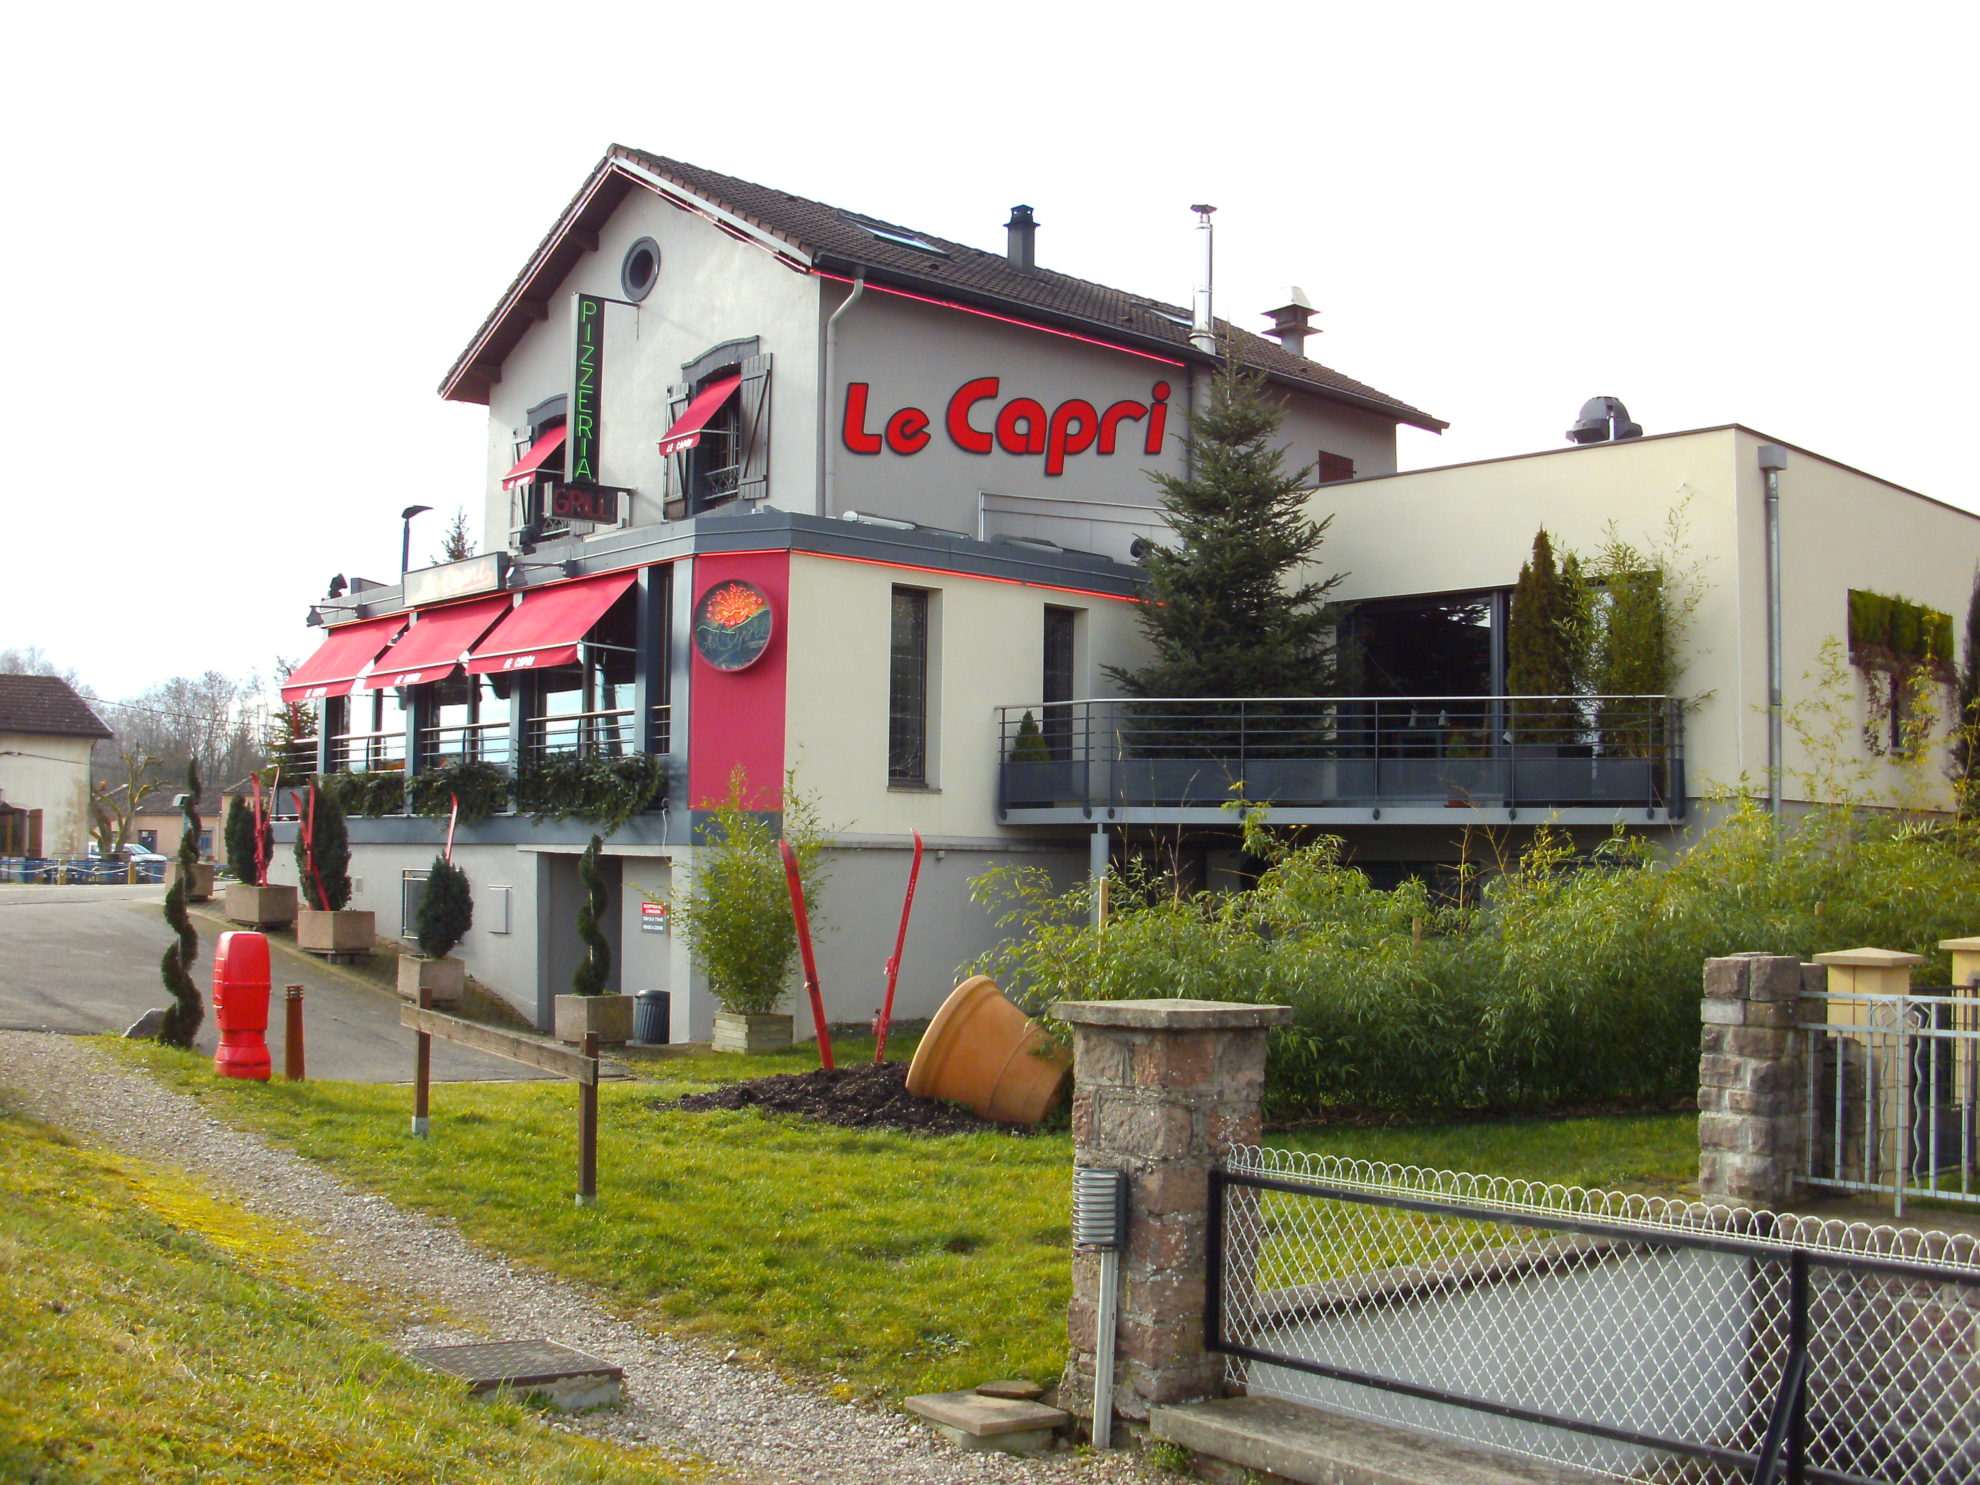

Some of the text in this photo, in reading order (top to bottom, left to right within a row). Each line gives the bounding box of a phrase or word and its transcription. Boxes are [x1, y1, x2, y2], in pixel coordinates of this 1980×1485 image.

[575, 300, 597, 481] PIZZERIA
[842, 376, 1171, 477] Le Capri
